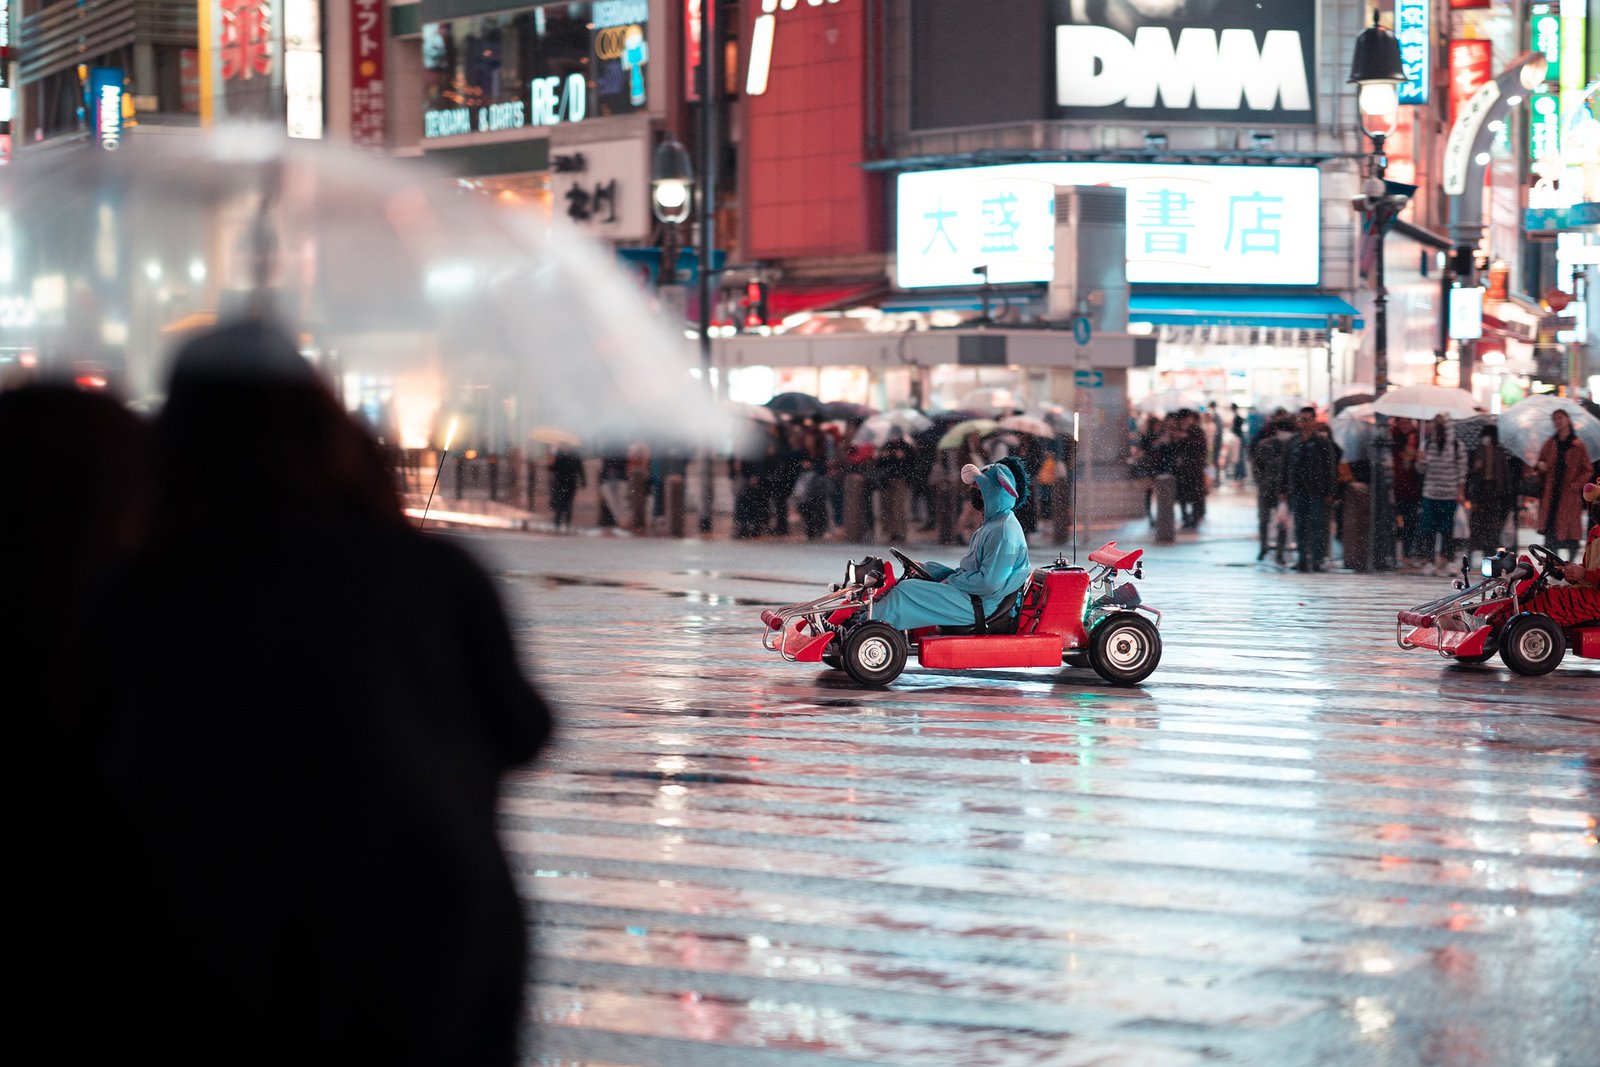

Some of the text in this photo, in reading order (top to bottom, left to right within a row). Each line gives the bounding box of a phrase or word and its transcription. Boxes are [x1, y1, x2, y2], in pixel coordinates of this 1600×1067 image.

[1055, 24, 1312, 111] DMM
[921, 188, 1284, 256] 大盛書店
